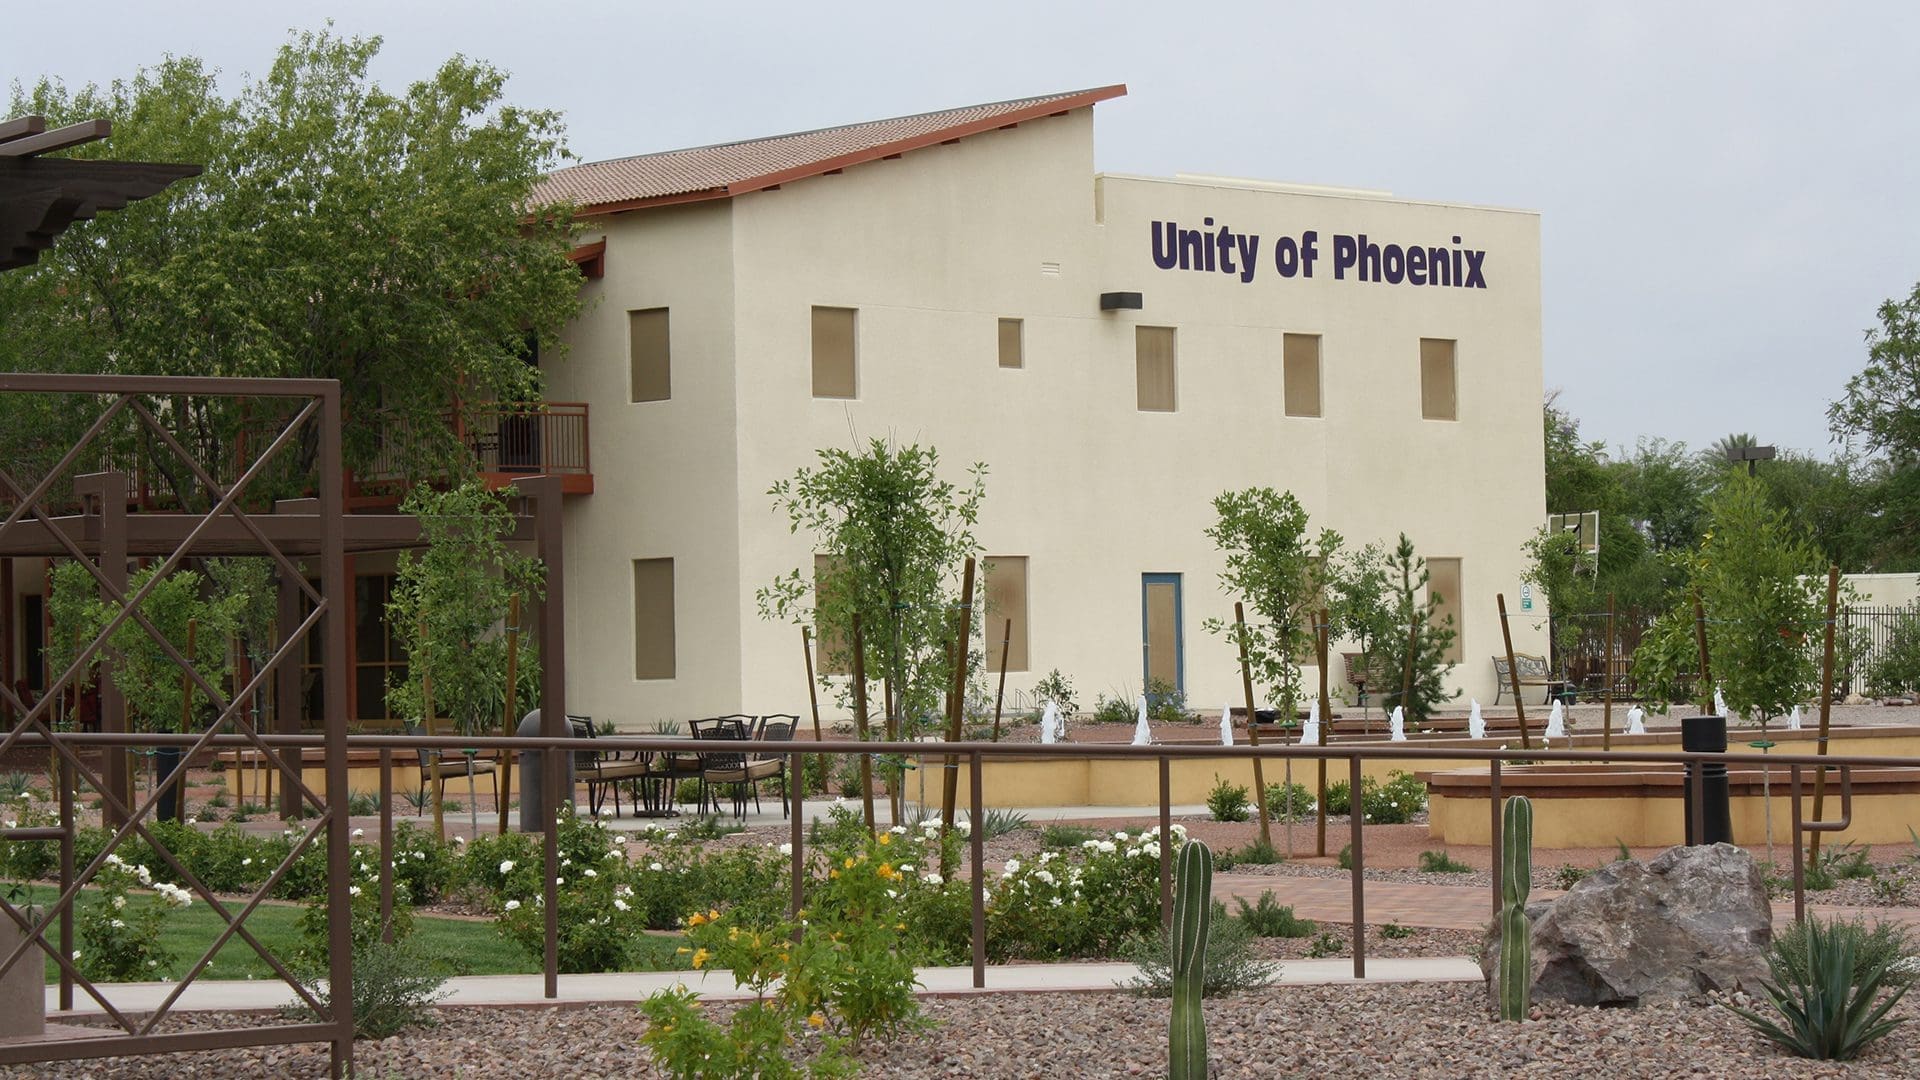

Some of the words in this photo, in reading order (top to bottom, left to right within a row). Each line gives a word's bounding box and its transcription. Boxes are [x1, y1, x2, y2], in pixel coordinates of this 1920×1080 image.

[1151, 217, 1260, 283] Unity
[1275, 231, 1319, 278] of
[1333, 234, 1488, 289] Phoenix
